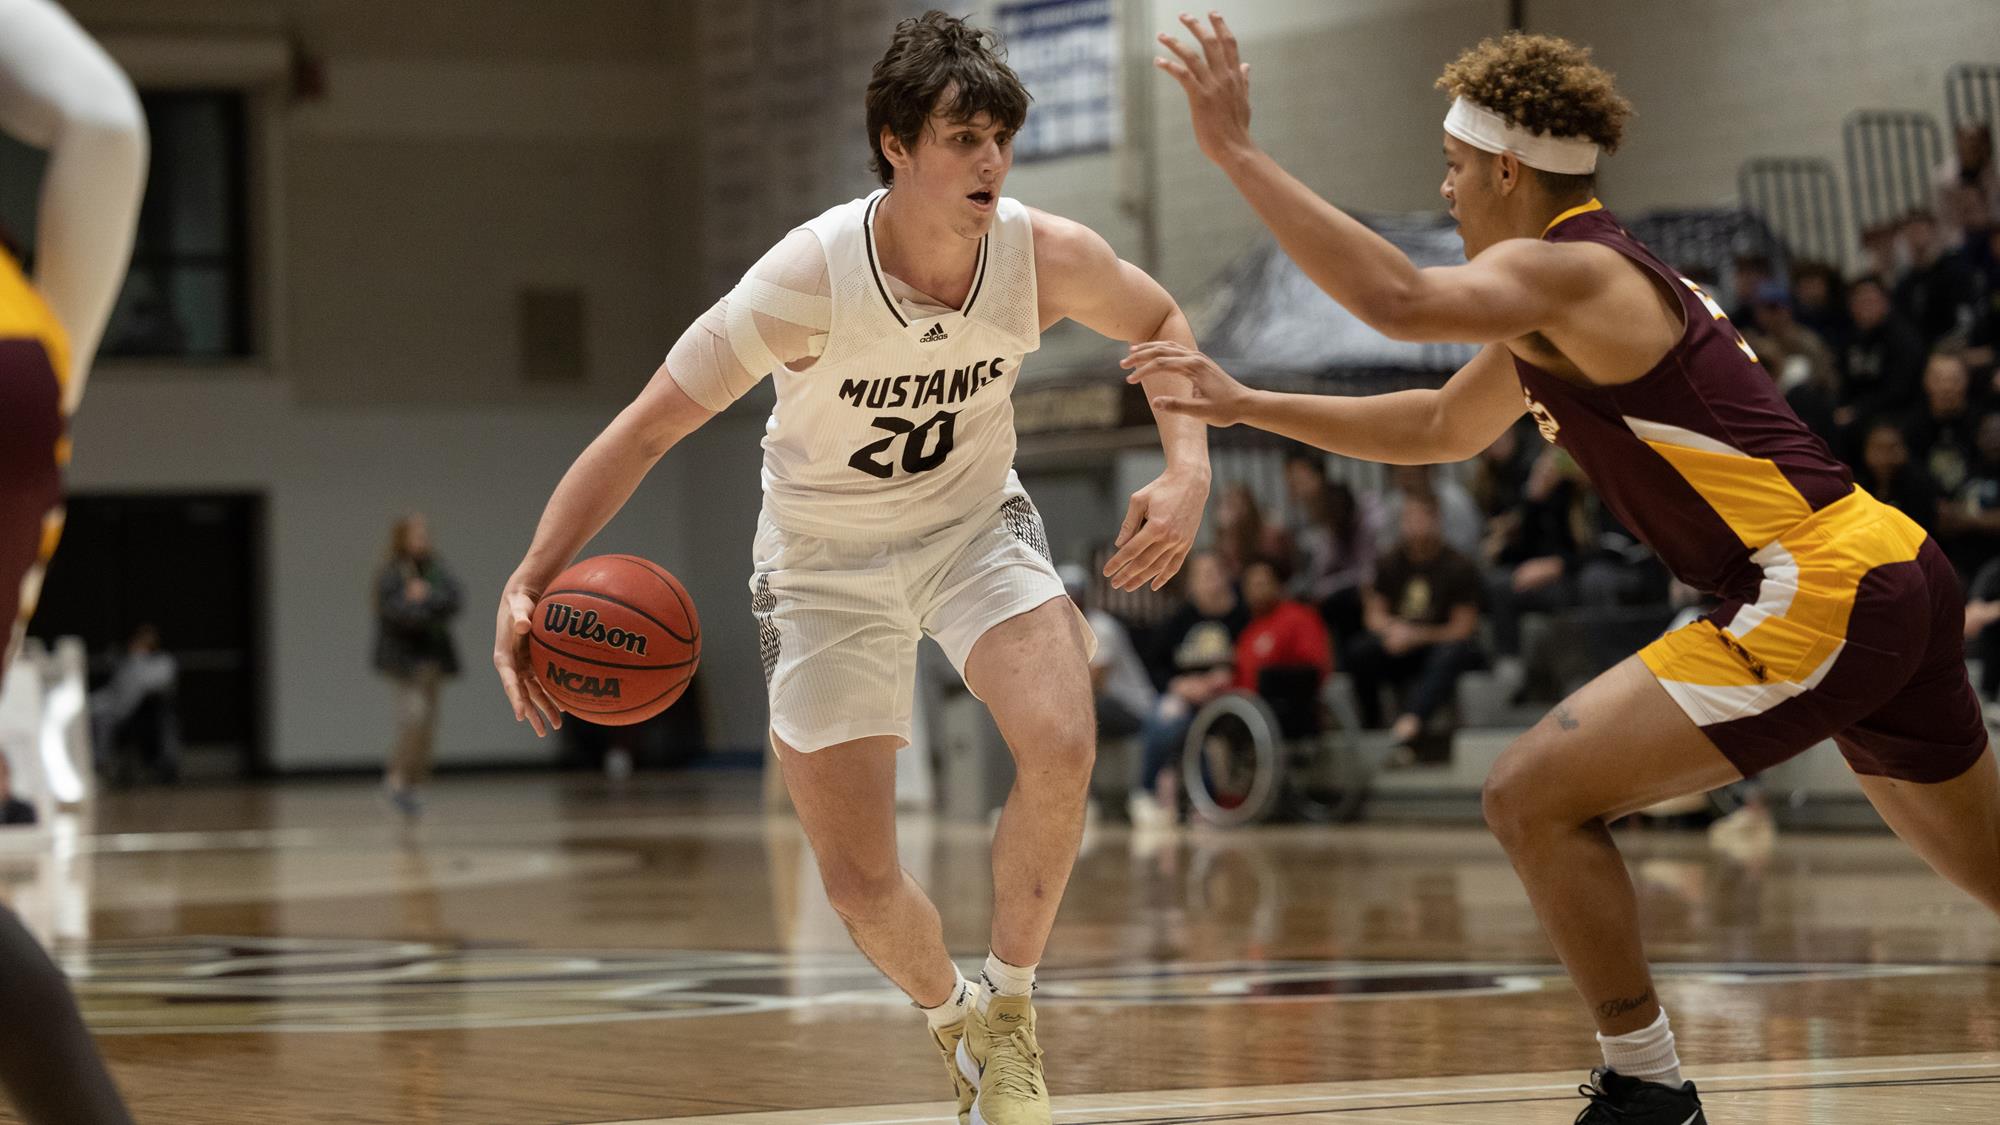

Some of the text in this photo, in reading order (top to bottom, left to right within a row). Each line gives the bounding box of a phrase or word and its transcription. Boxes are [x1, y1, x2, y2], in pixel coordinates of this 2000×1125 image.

[919, 333, 949, 343] adidas
[838, 357, 1006, 409] MUSTANGS
[848, 409, 965, 479] 20
[544, 603, 648, 656] Wilson
[546, 661, 621, 698] NCAA
